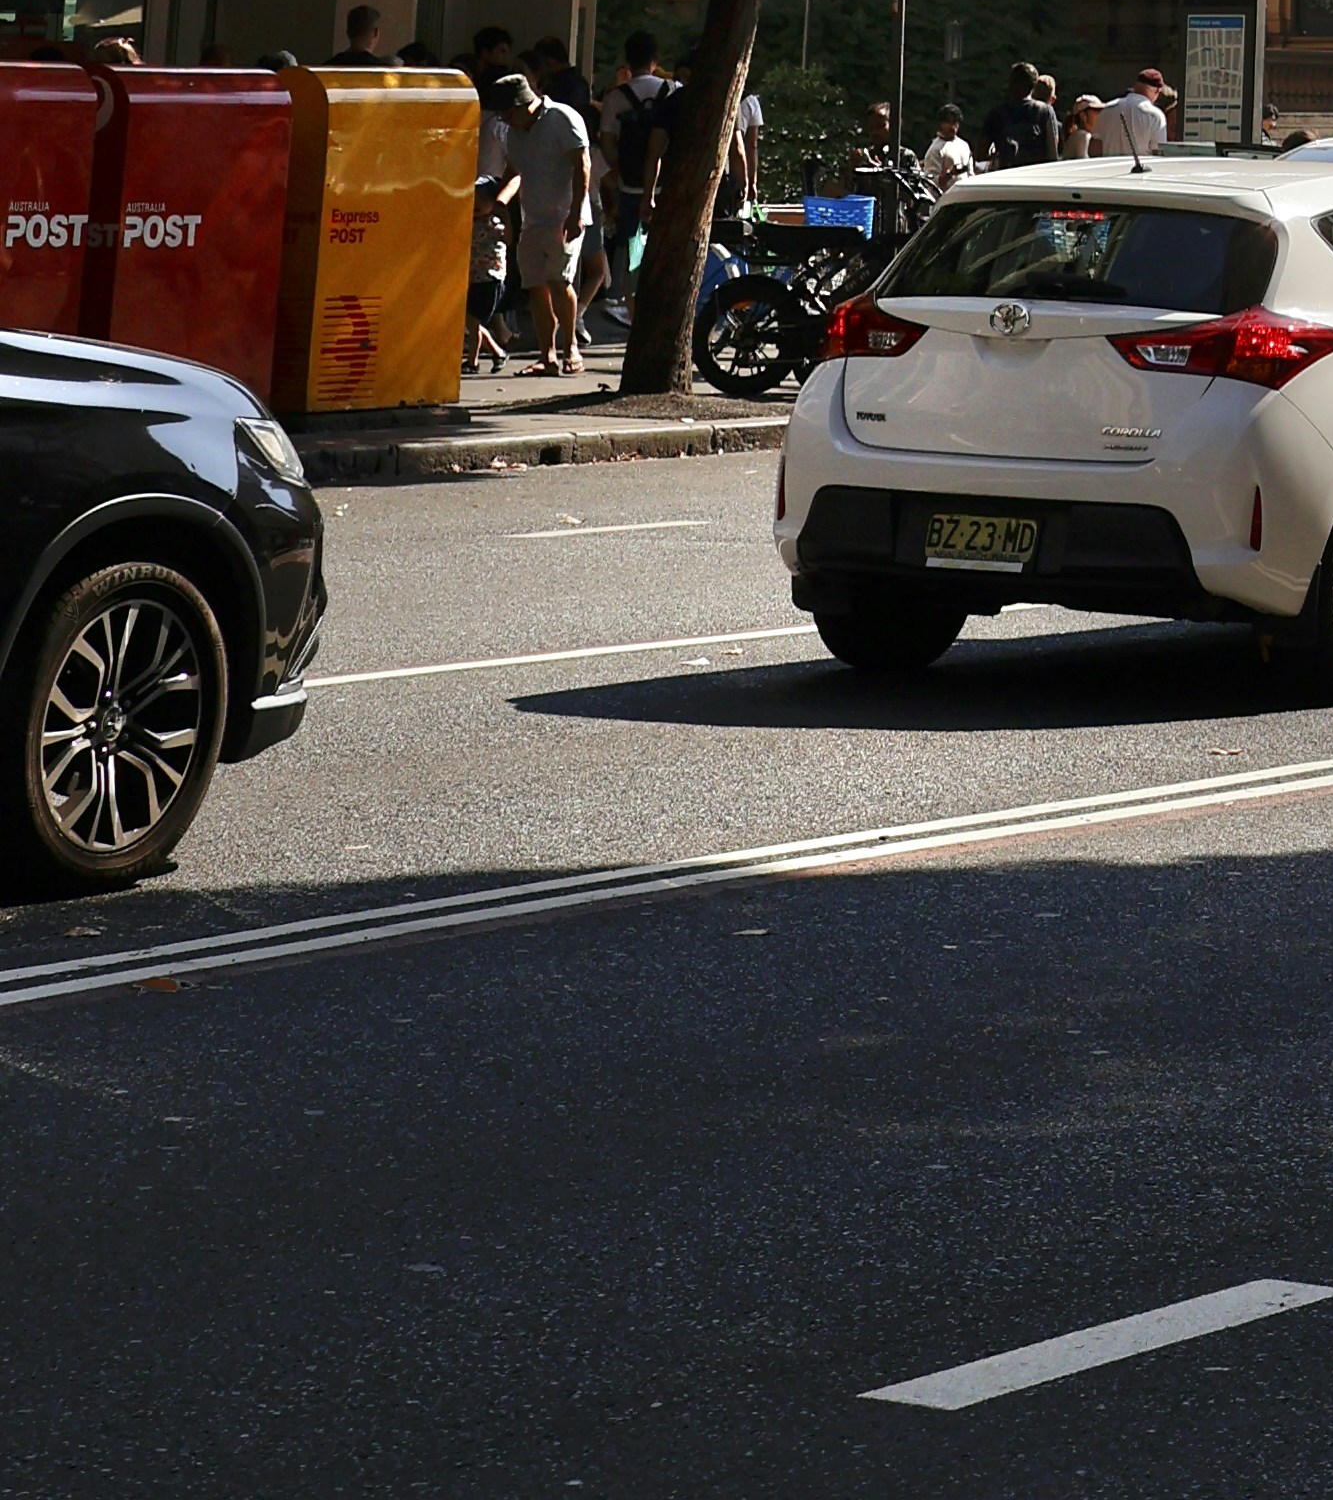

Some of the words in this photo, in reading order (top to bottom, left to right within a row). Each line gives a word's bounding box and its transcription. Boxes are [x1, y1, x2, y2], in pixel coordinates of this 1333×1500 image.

[8, 201, 50, 212] AUSTRALIA
[126, 202, 166, 213] AUSTRALIA
[331, 208, 380, 227] Express
[5, 214, 88, 248] POST
[123, 214, 202, 248] POST
[329, 228, 366, 244] POST
[1101, 425, 1163, 439] COROLLA
[92, 564, 181, 597] WINRUN
